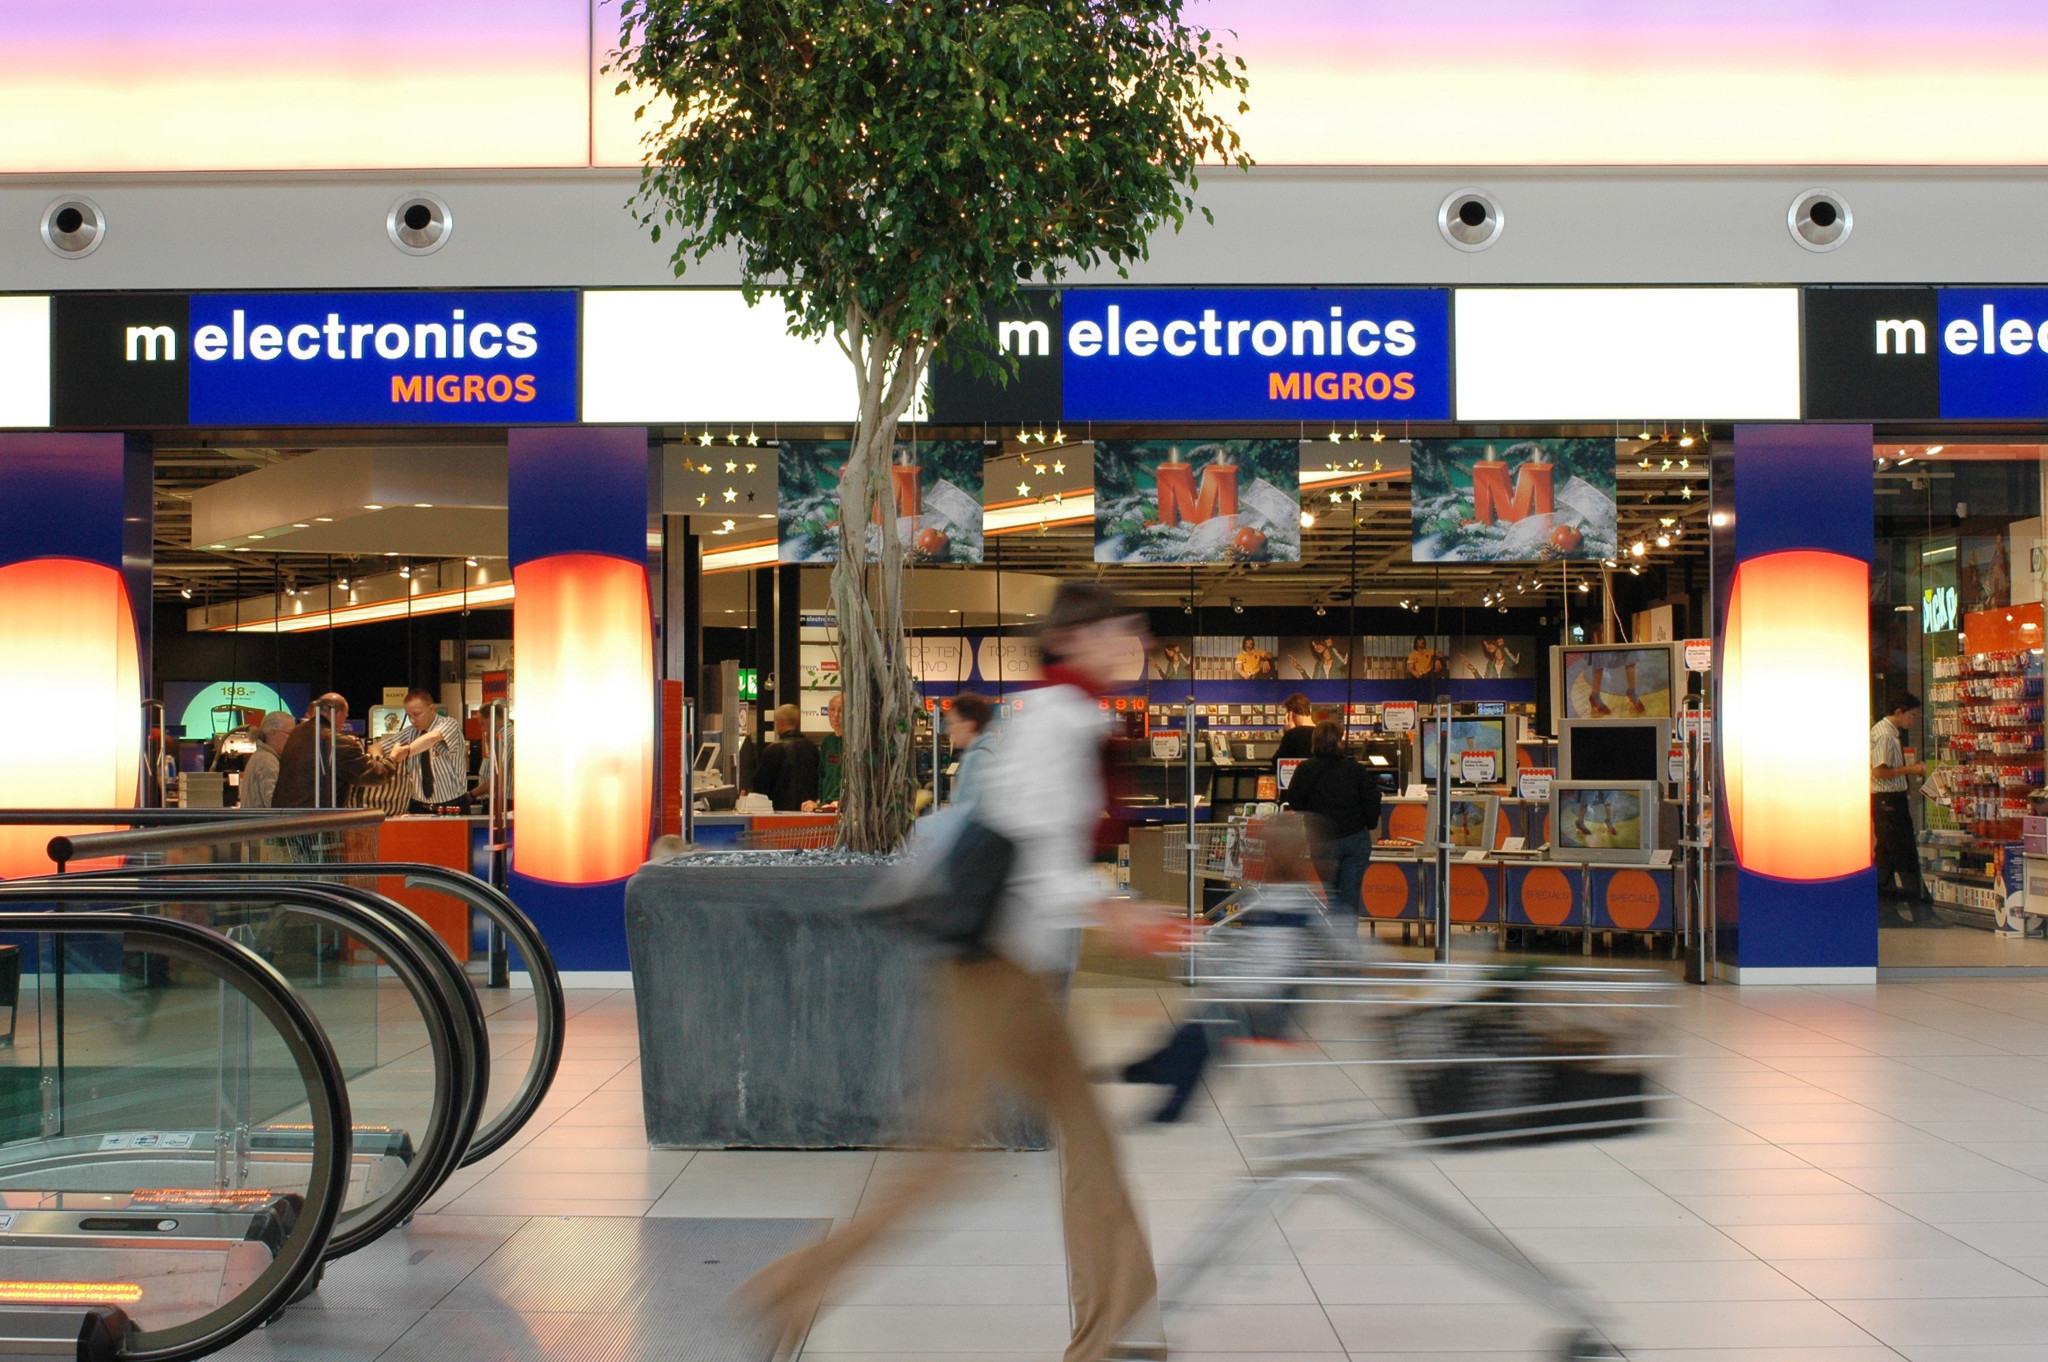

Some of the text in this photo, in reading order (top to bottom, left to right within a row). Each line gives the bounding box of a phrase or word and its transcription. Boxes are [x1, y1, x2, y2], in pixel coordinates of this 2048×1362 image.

[126, 309, 538, 361] m electronics
[998, 304, 1416, 357] m electronics
[1875, 319, 1926, 355] m
[391, 374, 537, 403] MIGROS
[1269, 371, 1416, 401] MIGROS
[987, 645, 1016, 657] TOP
[917, 660, 948, 673] DVD
[1006, 659, 1030, 672] CD
[1115, 698, 1127, 711] 9
[1131, 698, 1145, 711] 10
[1449, 887, 1486, 897] PECIALS
[1525, 889, 1570, 901] SPECIALS
[1609, 893, 1657, 904] SPECIALS
